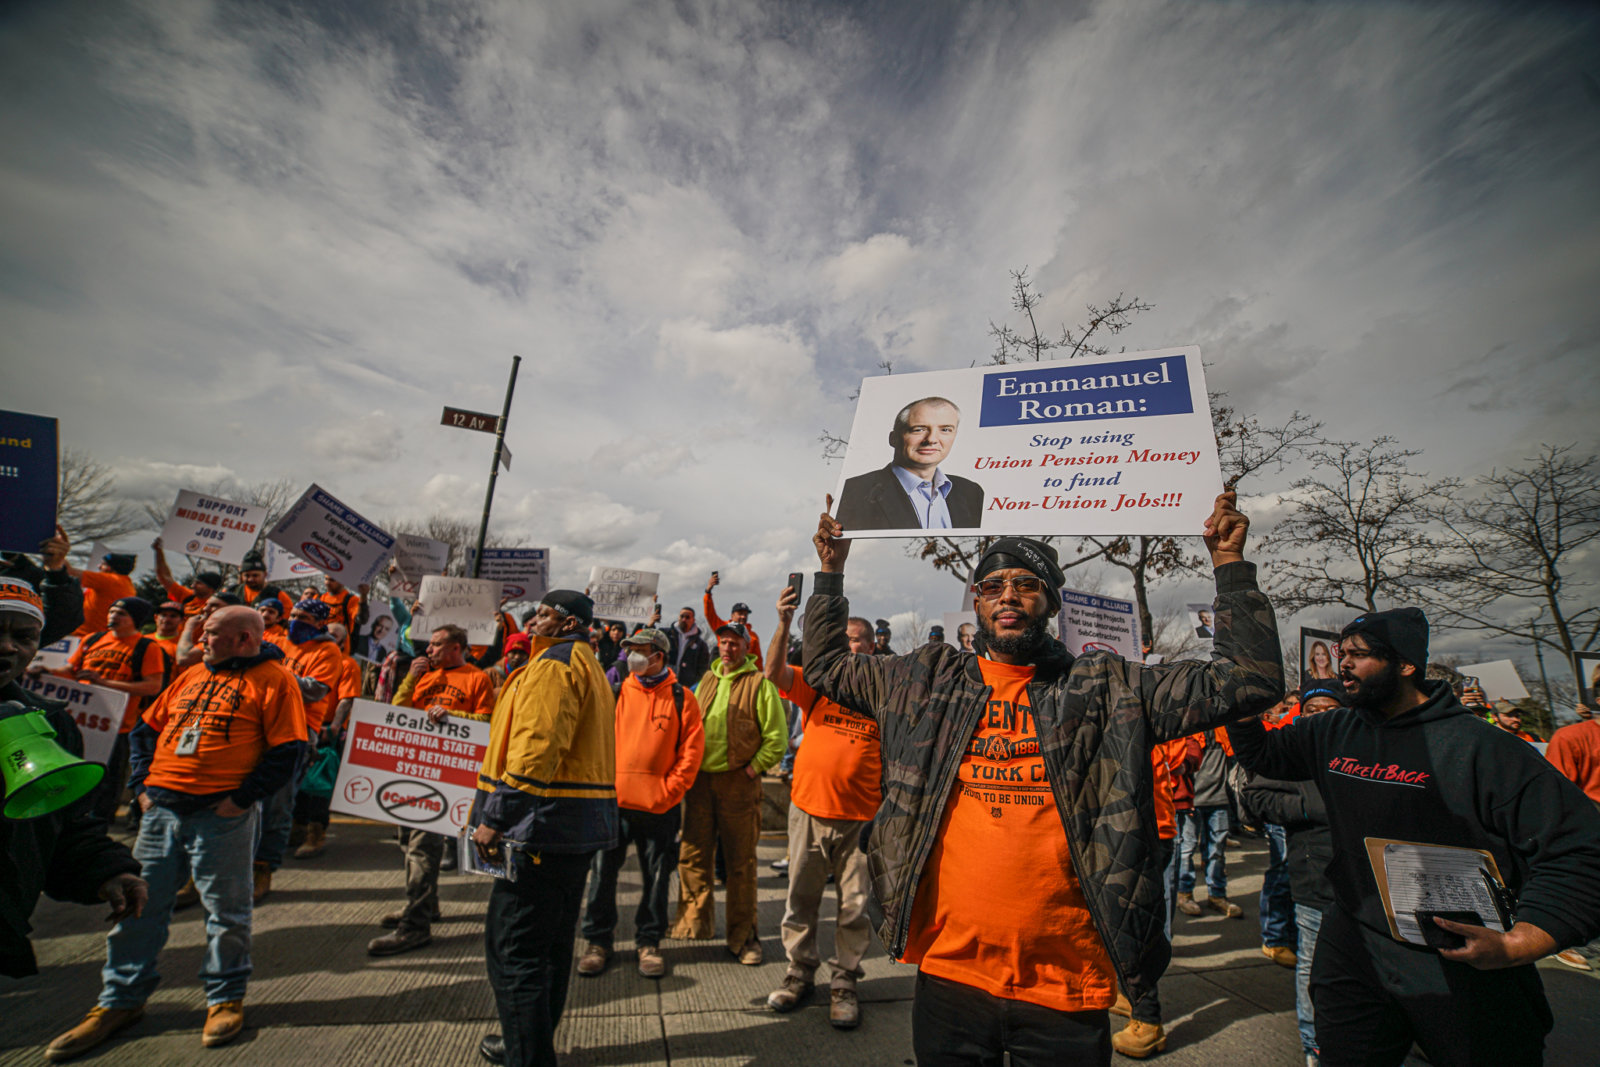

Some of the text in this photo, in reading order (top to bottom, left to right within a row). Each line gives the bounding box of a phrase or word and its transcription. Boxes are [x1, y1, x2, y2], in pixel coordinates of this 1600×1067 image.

[996, 362, 1172, 397] Emmanuel
[1018, 398, 1147, 420] Roman:
[453, 413, 485, 429] 12 Av
[1030, 431, 1135, 450] Stop using
[974, 449, 1200, 470] Union Pension Money
[1043, 471, 1122, 491] to fund
[197, 498, 247, 517] SUPPORT
[988, 493, 1183, 512] Non-Union Jobs!!!
[175, 507, 256, 534] MIDDLE CLASS
[317, 494, 344, 516] SHAME
[345, 513, 358, 525] ON
[358, 522, 390, 546] ALLIANZ
[324, 513, 368, 545] Exploitation
[195, 527, 225, 541] JOBS
[1065, 592, 1089, 605] SHAME
[1103, 600, 1130, 612] ALLIANZ
[1068, 617, 1081, 625] That
[1071, 607, 1126, 625] For Funding Projects
[1078, 629, 1121, 642] SubContractors
[20, 678, 94, 705] PPORT
[72, 710, 111, 732] ASS
[385, 711, 471, 739] #CalSTRS
[824, 714, 843, 725] NEW
[845, 719, 867, 731] YORK
[374, 727, 477, 757] CALIFORNIA STATE
[355, 738, 483, 773] TEACHER'S RETIREMEN
[396, 761, 442, 780] SYSTEM
[971, 764, 1024, 782] YORK
[984, 793, 996, 803] TO
[999, 794, 1011, 804] BE
[1014, 796, 1045, 806] UNION
